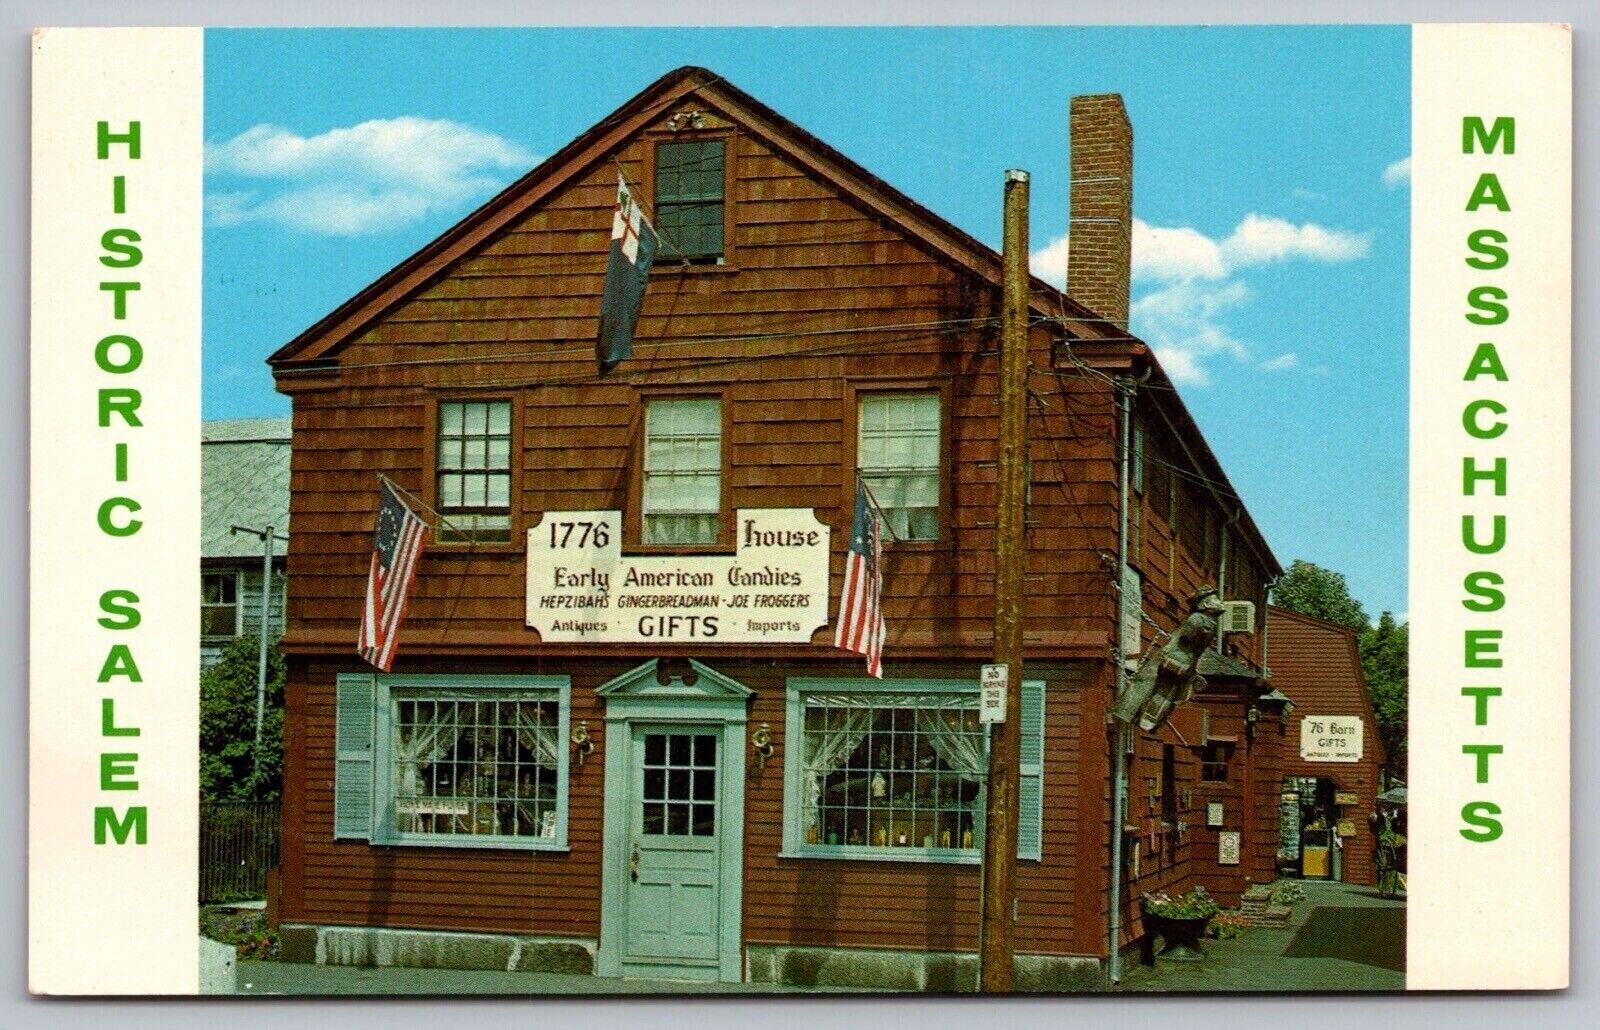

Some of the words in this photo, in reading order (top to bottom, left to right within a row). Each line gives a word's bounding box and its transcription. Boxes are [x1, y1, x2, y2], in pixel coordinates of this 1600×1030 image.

[95, 121, 144, 536] HISTORIC
[1460, 117, 1515, 842] MASSACHUSETTS
[550, 521, 609, 548] 1776
[554, 566, 610, 594] Early
[623, 566, 714, 587] American
[728, 566, 802, 586] Candies
[540, 595, 609, 608] HEPZIBAHS
[727, 595, 749, 608] JOE
[754, 594, 810, 608] FROGGERS
[551, 620, 607, 635] Antiques
[638, 616, 718, 637] GIFTS
[747, 619, 800, 635] Imports
[95, 590, 147, 845] SALEM
[1318, 739, 1346, 748] GIFTS
